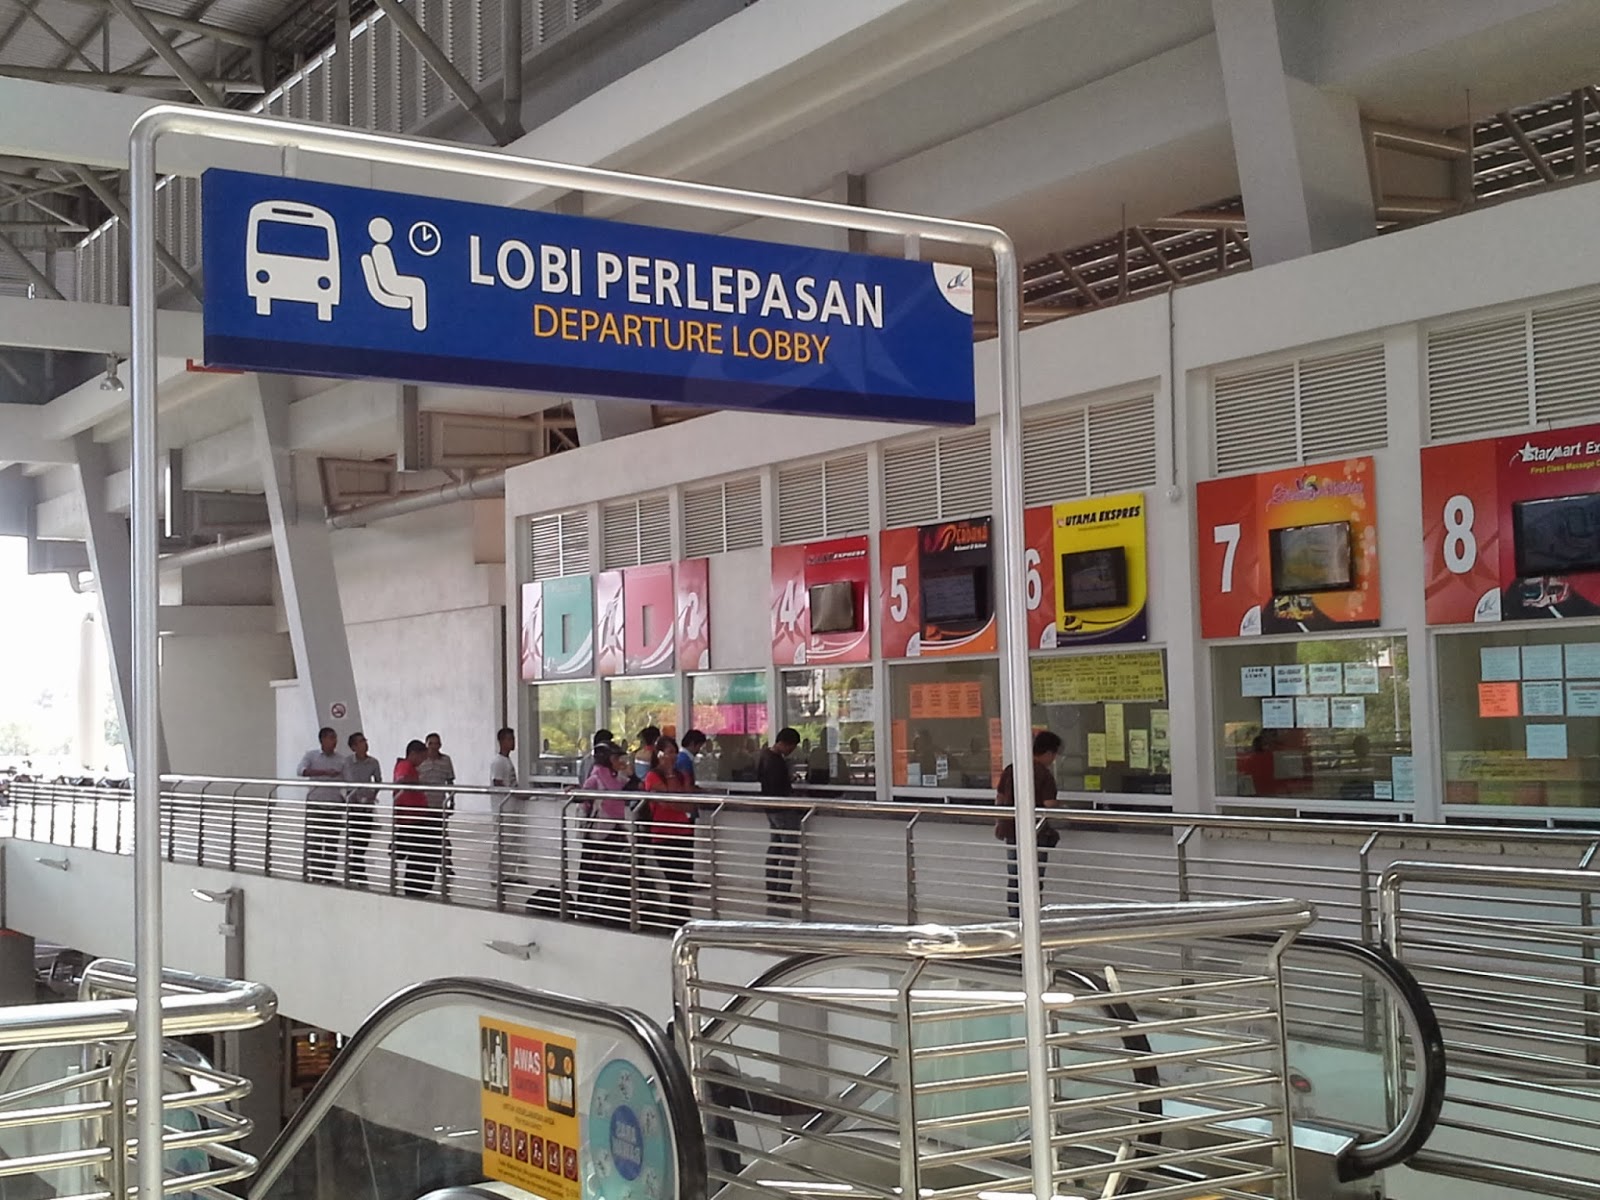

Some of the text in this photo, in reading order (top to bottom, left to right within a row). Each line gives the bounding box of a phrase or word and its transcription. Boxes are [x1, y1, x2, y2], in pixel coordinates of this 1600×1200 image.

[469, 234, 884, 329] LOBI PERLEPASAN
[533, 303, 831, 364] DEPARTURE LOBBY
[1065, 512, 1097, 527] UTAMA
[1099, 505, 1141, 522] EKSPRES
[1443, 494, 1477, 574] 8
[833, 549, 867, 560] EXPRESS
[1025, 548, 1042, 611] 6
[1214, 523, 1241, 593] 7
[781, 579, 798, 632] 4
[890, 565, 908, 623] 5
[513, 1046, 541, 1076] AWAS
